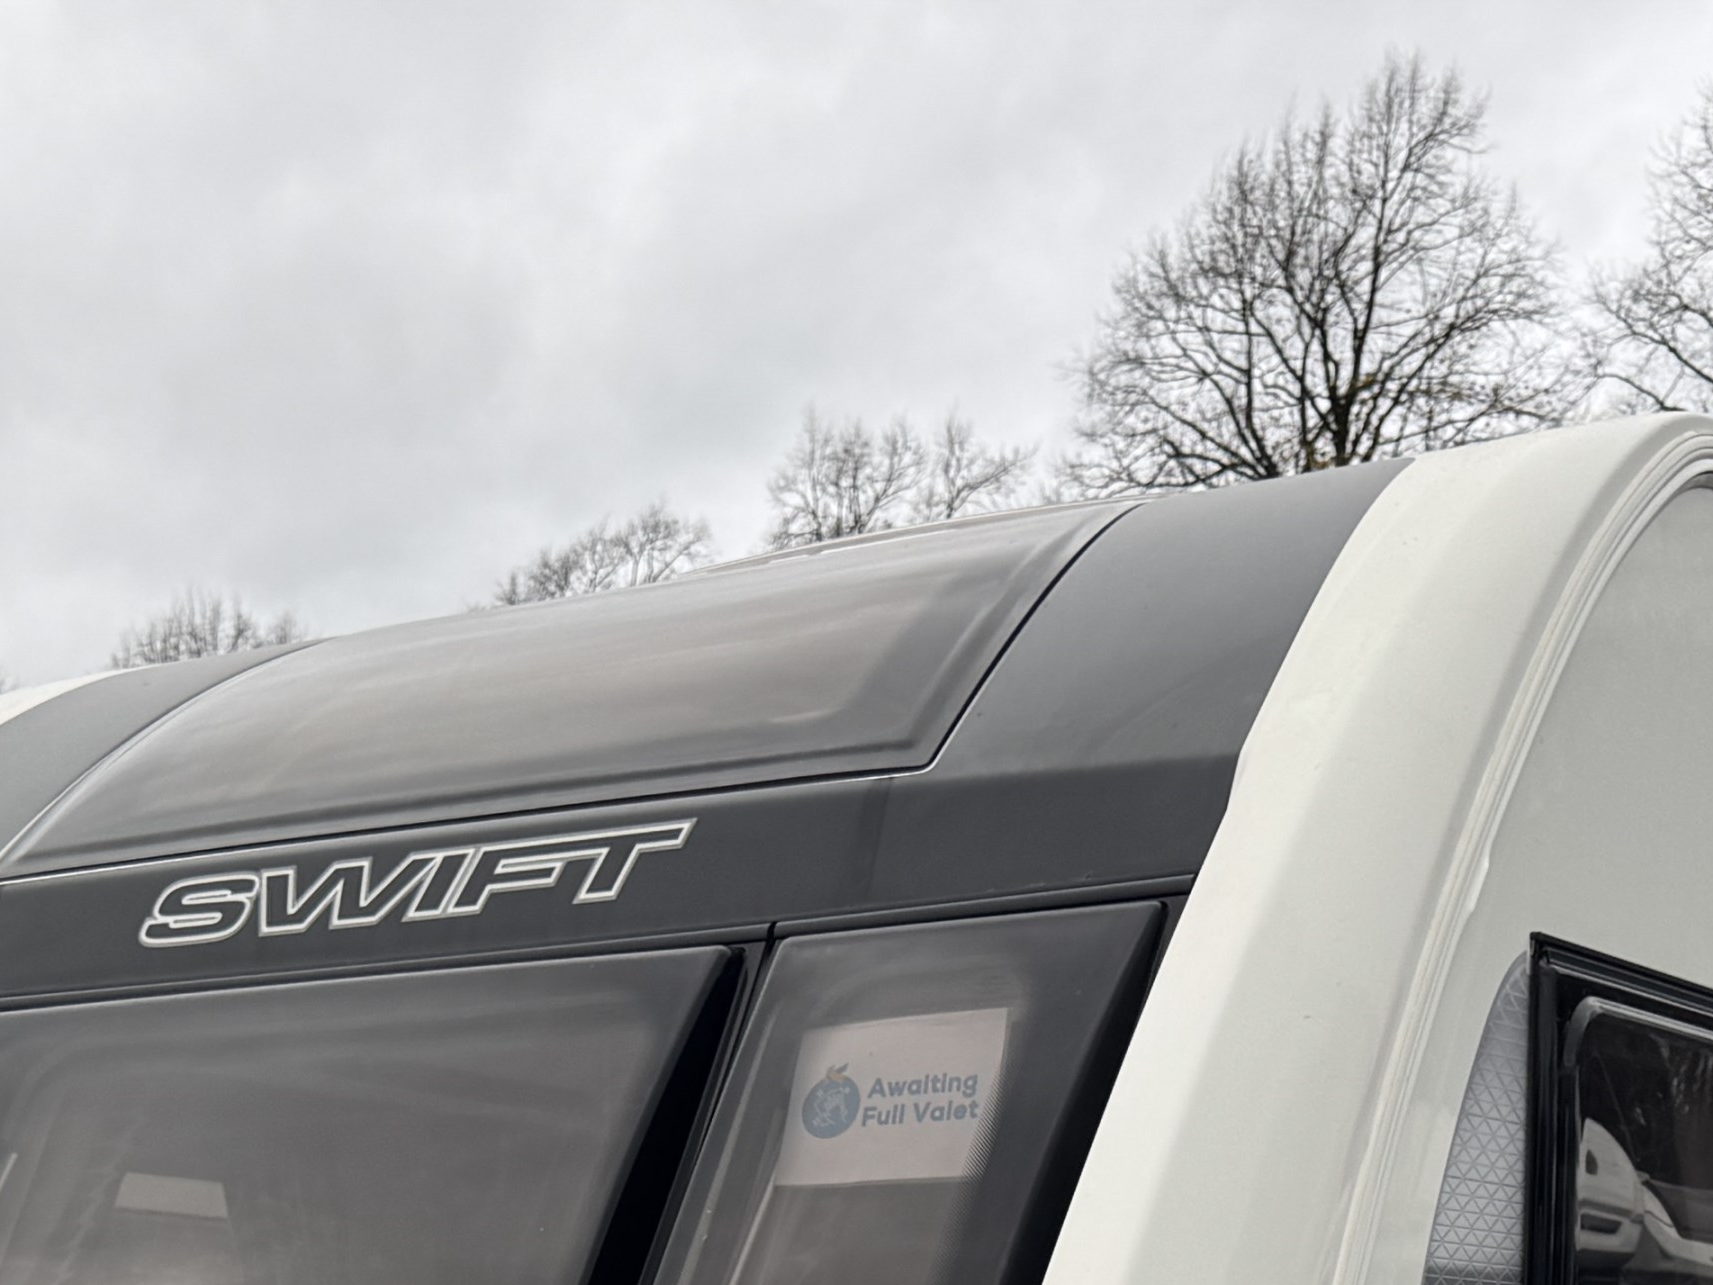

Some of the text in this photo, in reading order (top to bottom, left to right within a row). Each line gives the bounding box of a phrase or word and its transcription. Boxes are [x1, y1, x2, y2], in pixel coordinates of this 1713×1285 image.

[139, 817, 698, 948] SWIFT
[867, 1073, 979, 1099] Awaiting
[862, 1100, 980, 1127] Full Valet
